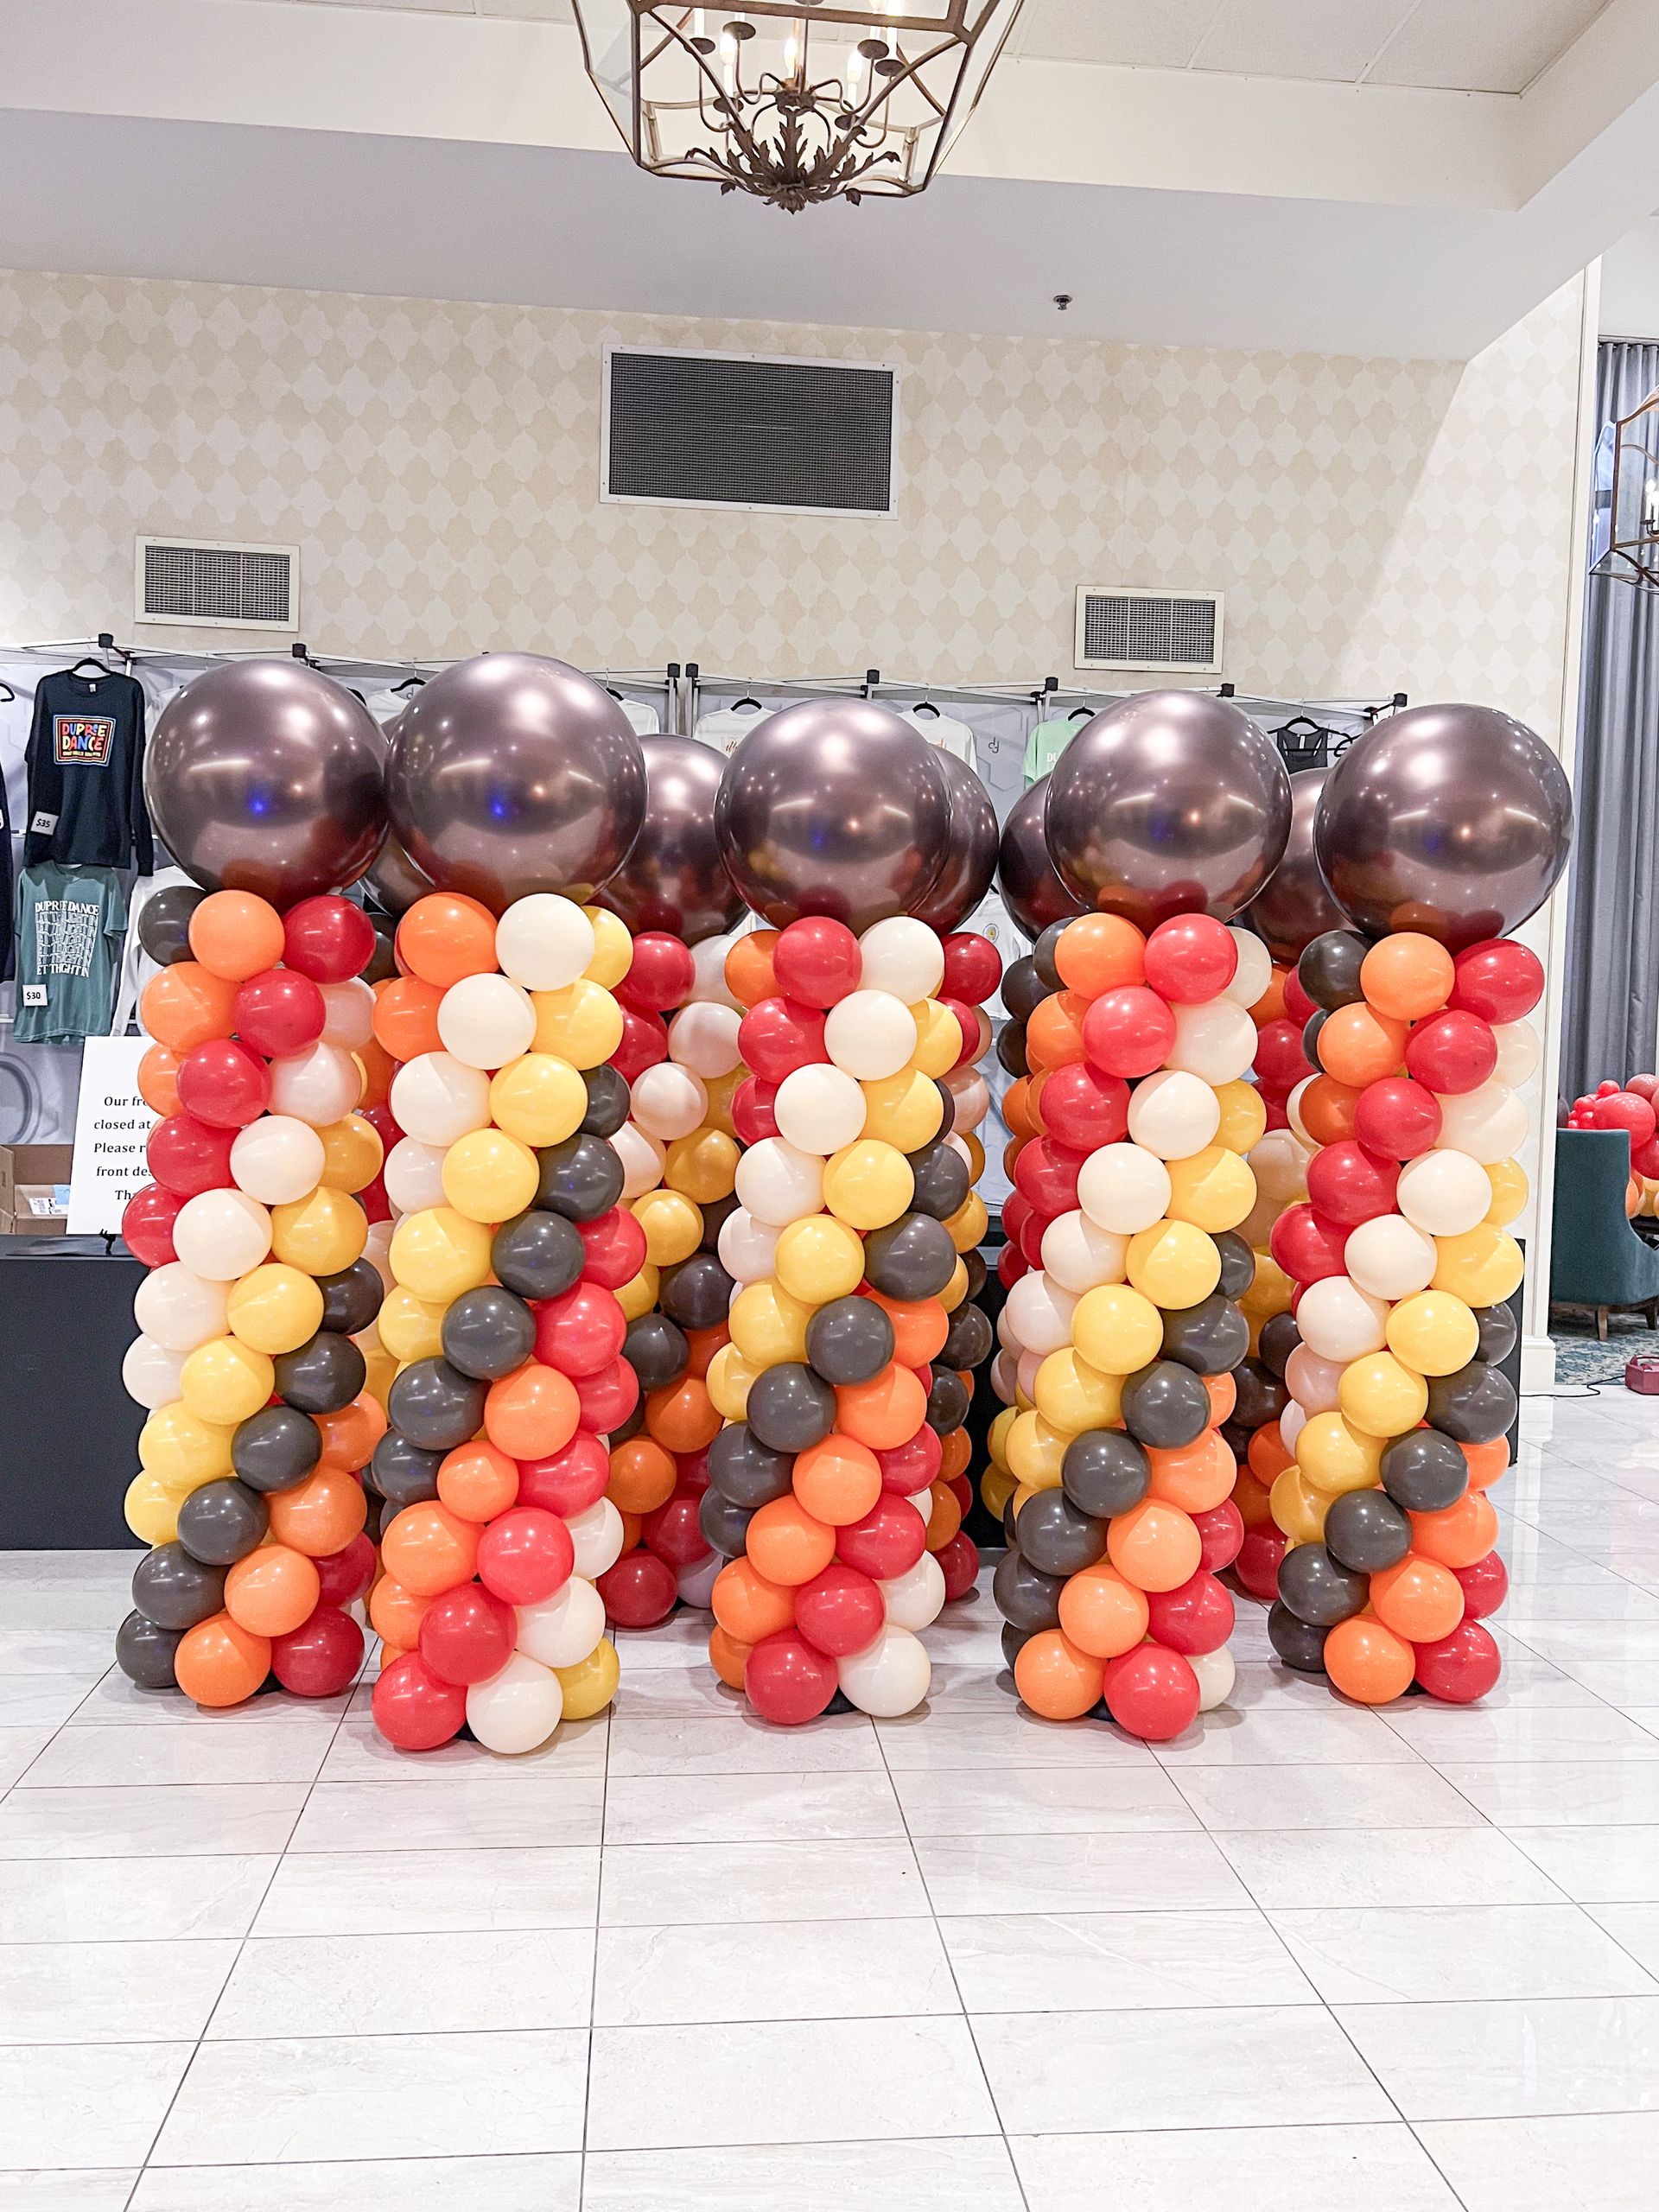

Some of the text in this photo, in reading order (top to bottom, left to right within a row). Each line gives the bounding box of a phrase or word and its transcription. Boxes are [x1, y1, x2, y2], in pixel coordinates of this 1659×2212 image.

[61, 723, 107, 737] DUPREE
[61, 734, 105, 752] DANCE
[35, 817, 51, 829] $35
[67, 901, 99, 916] DANCE
[26, 991, 41, 1001] $30
[104, 1096, 129, 1107] Our
[93, 1119, 151, 1130] closed at
[93, 1142, 136, 1154] Please
[96, 1166, 129, 1177] front
